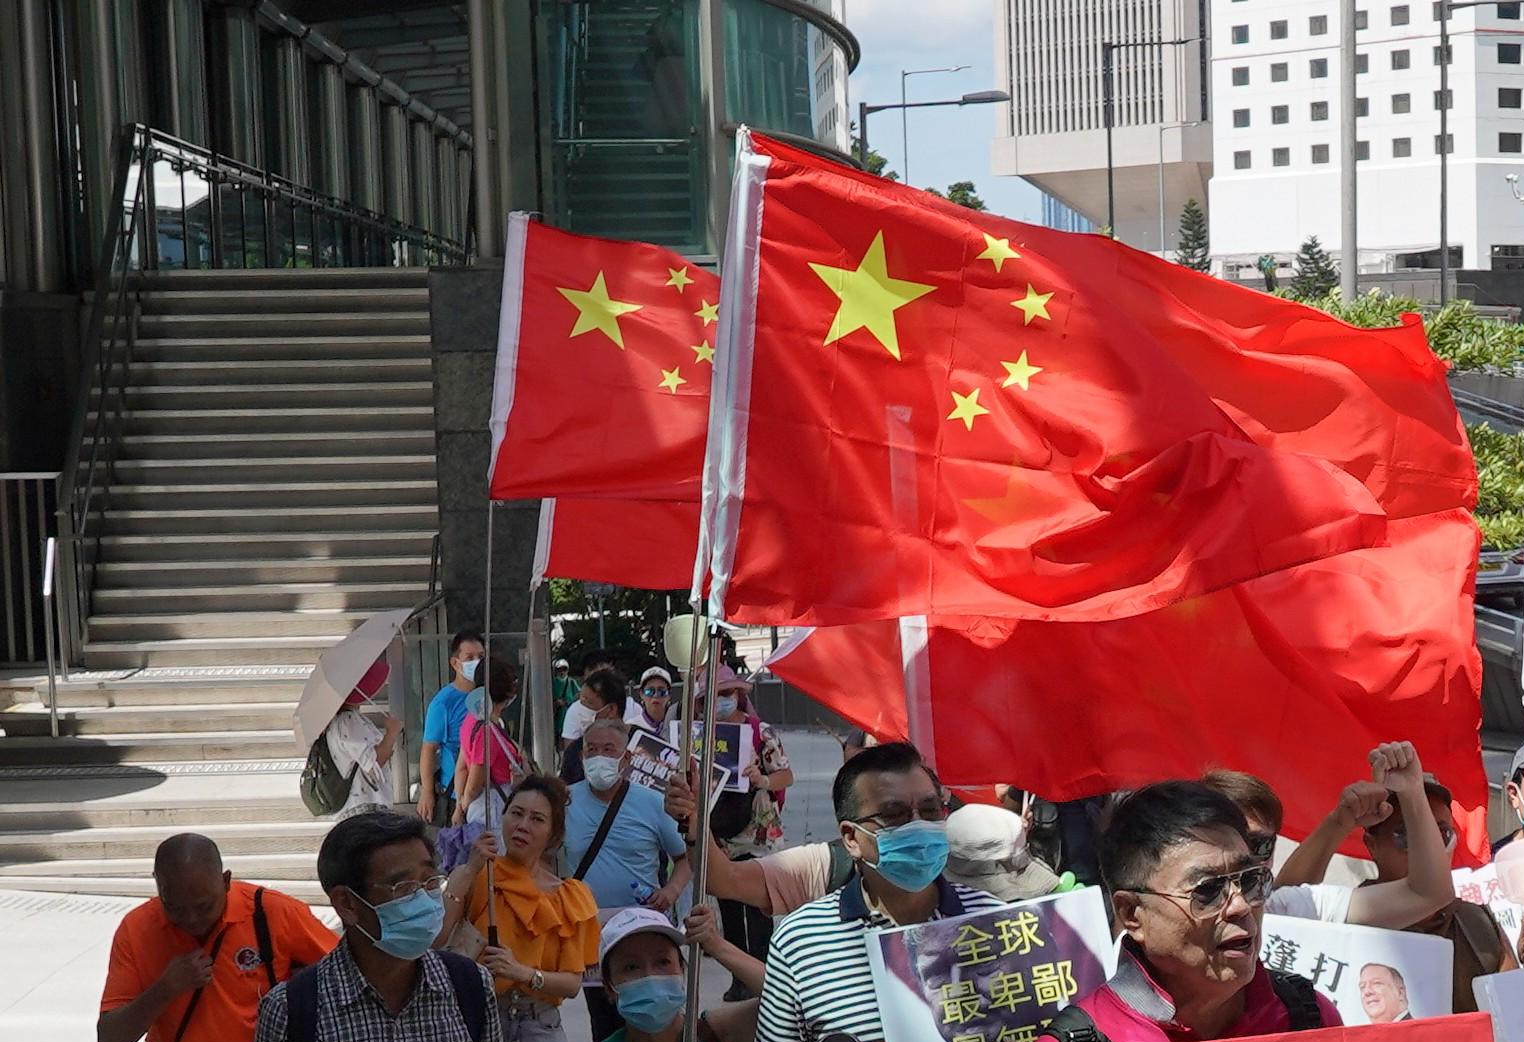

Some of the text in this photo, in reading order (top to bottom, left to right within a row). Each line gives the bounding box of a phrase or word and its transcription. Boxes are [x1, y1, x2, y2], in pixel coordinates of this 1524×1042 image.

[953, 911, 1046, 967] 全球
[939, 960, 1078, 1025] 最卑鄙
